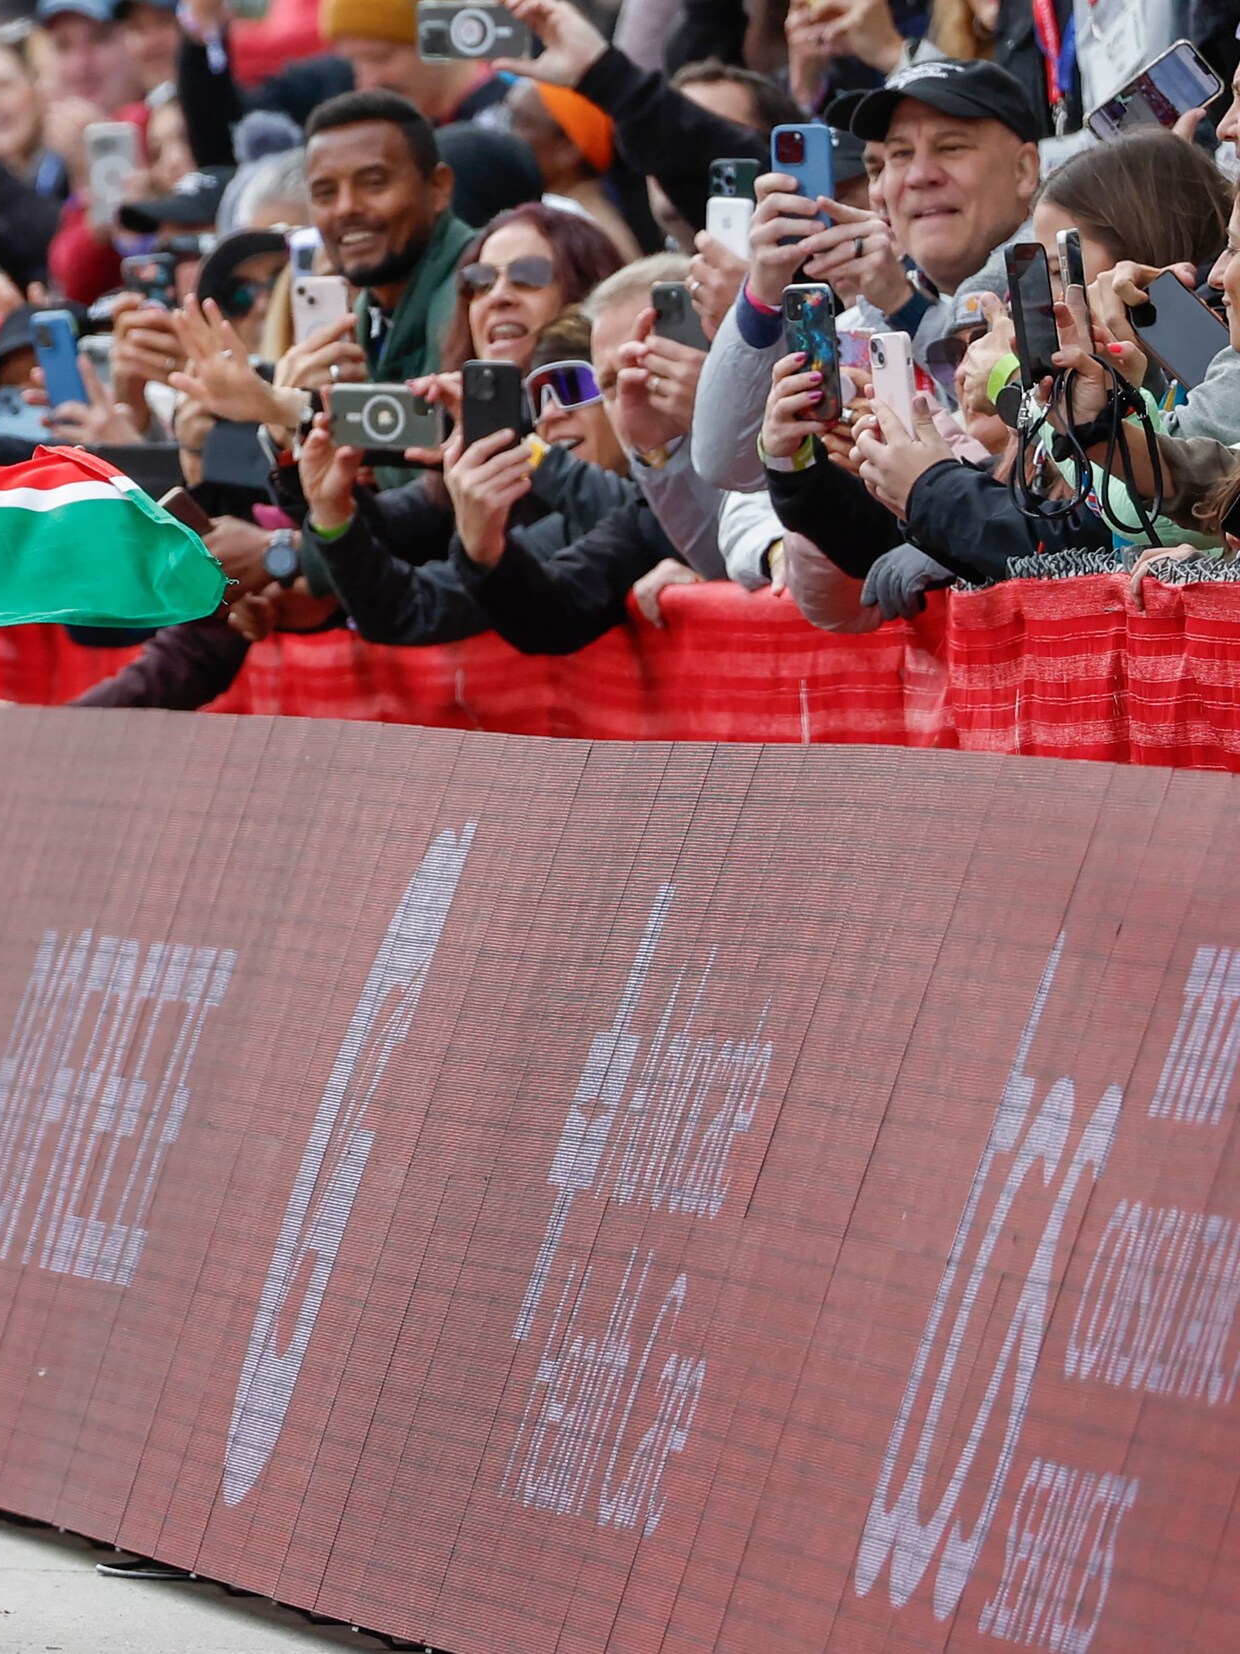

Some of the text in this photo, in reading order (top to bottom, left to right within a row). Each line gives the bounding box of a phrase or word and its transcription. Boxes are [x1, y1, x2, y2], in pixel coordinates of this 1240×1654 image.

[593, 943, 774, 1220] Advocate
[497, 1246, 707, 1538] Health Care
[978, 1456, 1140, 1654] SERVICES
